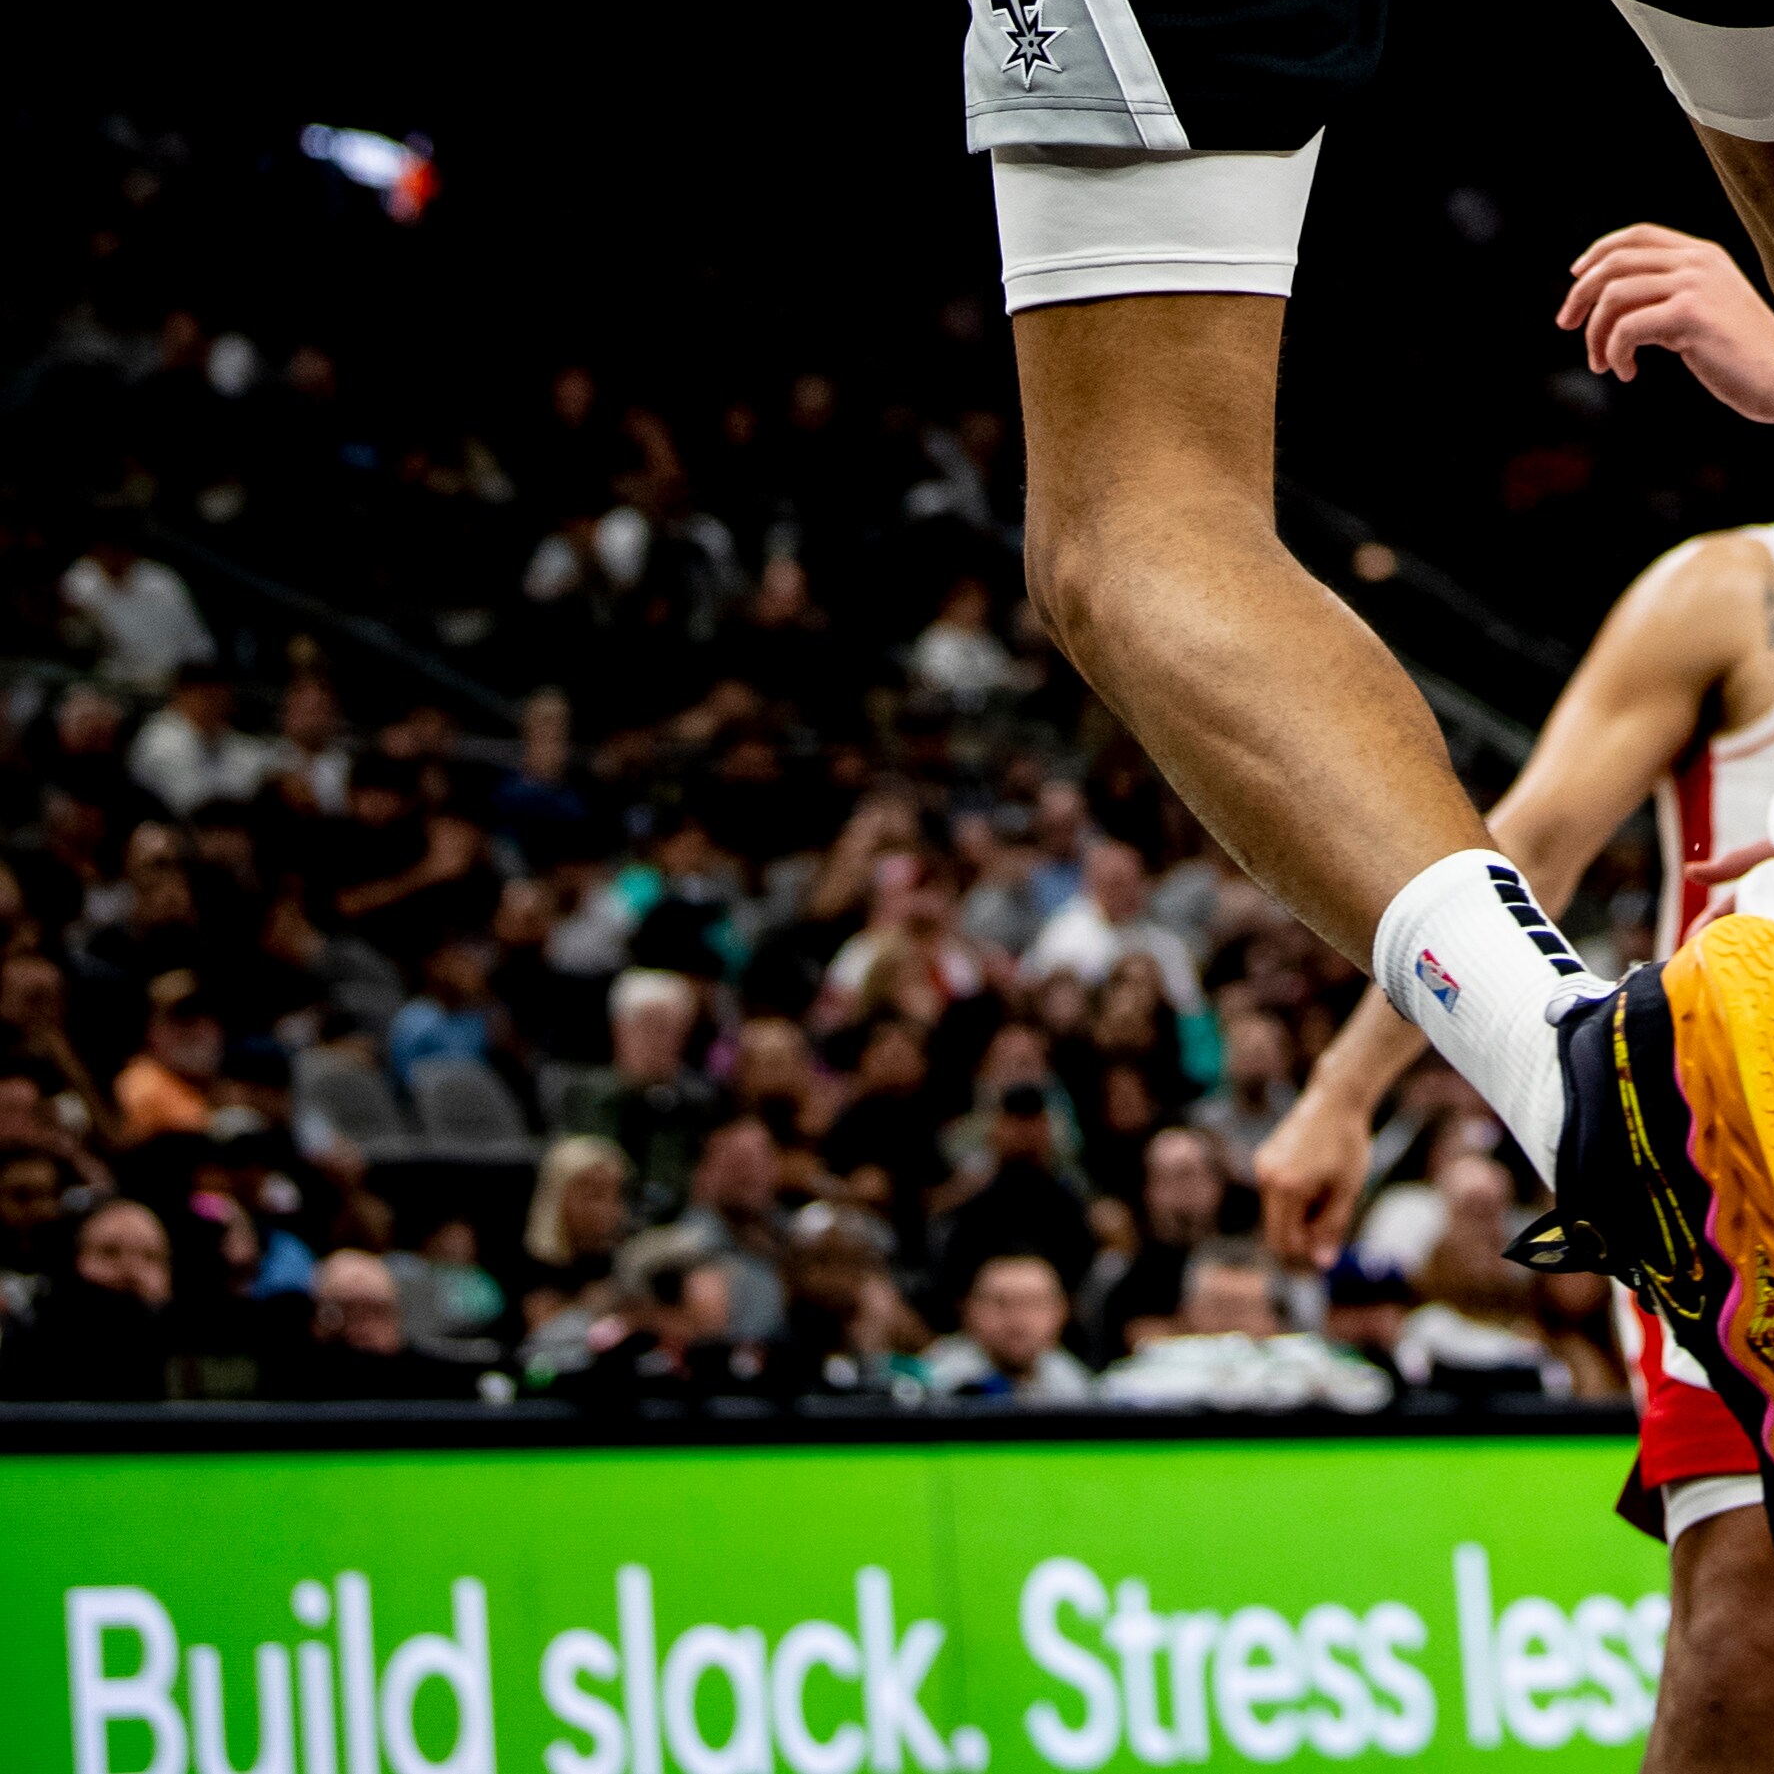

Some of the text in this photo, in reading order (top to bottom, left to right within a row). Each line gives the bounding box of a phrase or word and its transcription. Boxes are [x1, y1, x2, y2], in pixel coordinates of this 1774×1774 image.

[66, 1570, 498, 1774] Build
[540, 1563, 991, 1774] slack.
[1019, 1555, 1438, 1772] Stress
